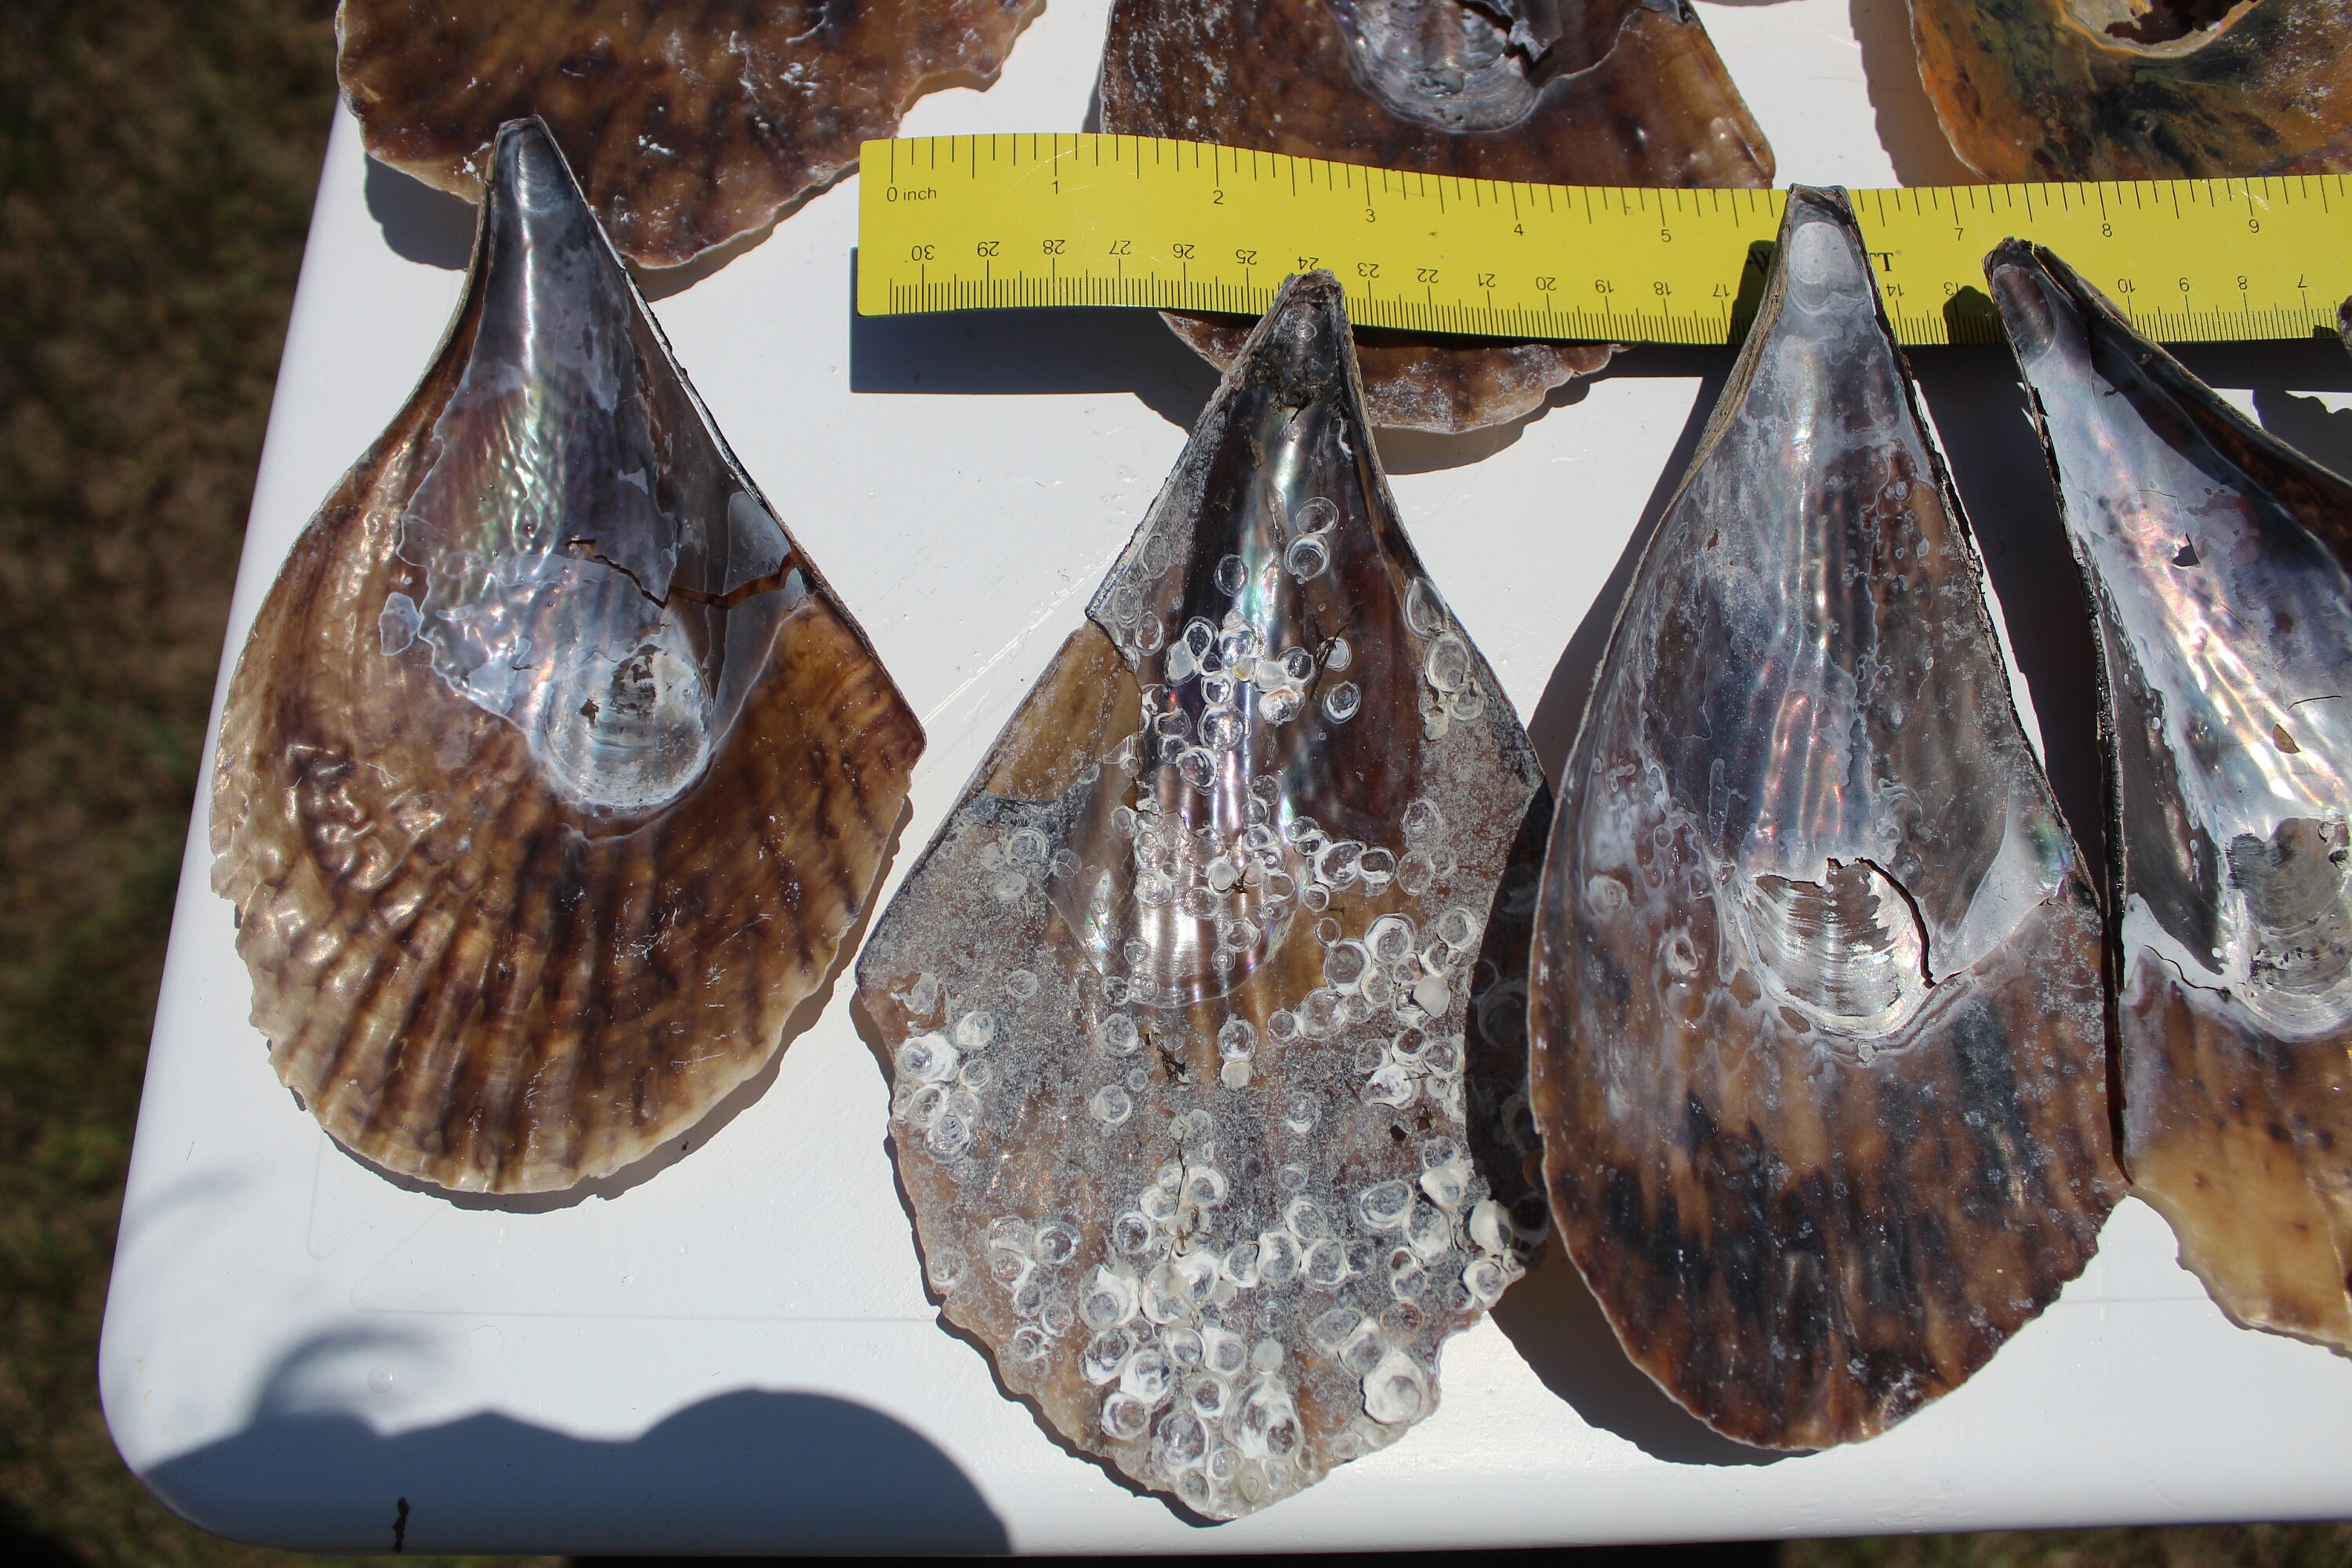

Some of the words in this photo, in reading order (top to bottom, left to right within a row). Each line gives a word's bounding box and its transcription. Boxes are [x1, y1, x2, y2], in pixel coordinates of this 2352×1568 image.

[886, 186, 898, 201] 0
[902, 187, 937, 201] inch
[1051, 180, 1058, 194] 1
[1213, 190, 1224, 204] 2
[1364, 209, 1376, 223] 3
[1513, 223, 1523, 236] 4
[1661, 229, 1671, 242] 5
[1953, 227, 1963, 241] 7
[2102, 223, 2112, 237] 8
[2249, 219, 2259, 232] 9
[911, 244, 935, 260] 30
[977, 240, 999, 256] 29
[1042, 239, 1065, 255] 28
[1109, 239, 1131, 255] 27
[1172, 243, 1195, 259] 26
[1235, 249, 1257, 265] 25
[1297, 256, 1319, 270] 24
[1357, 262, 1379, 278] 23
[1417, 267, 1438, 284] 22
[1477, 273, 1496, 288] 21
[1535, 276, 1556, 291] 20
[1595, 279, 1613, 293] 19
[1653, 281, 1671, 295] 18
[1944, 281, 1962, 295] 13
[2118, 278, 2136, 293] 10
[2179, 276, 2189, 291] 9
[2236, 275, 2248, 290] 8
[2296, 274, 2307, 288] 7
[1712, 283, 1730, 297] 17
[1886, 284, 1904, 297] 14
